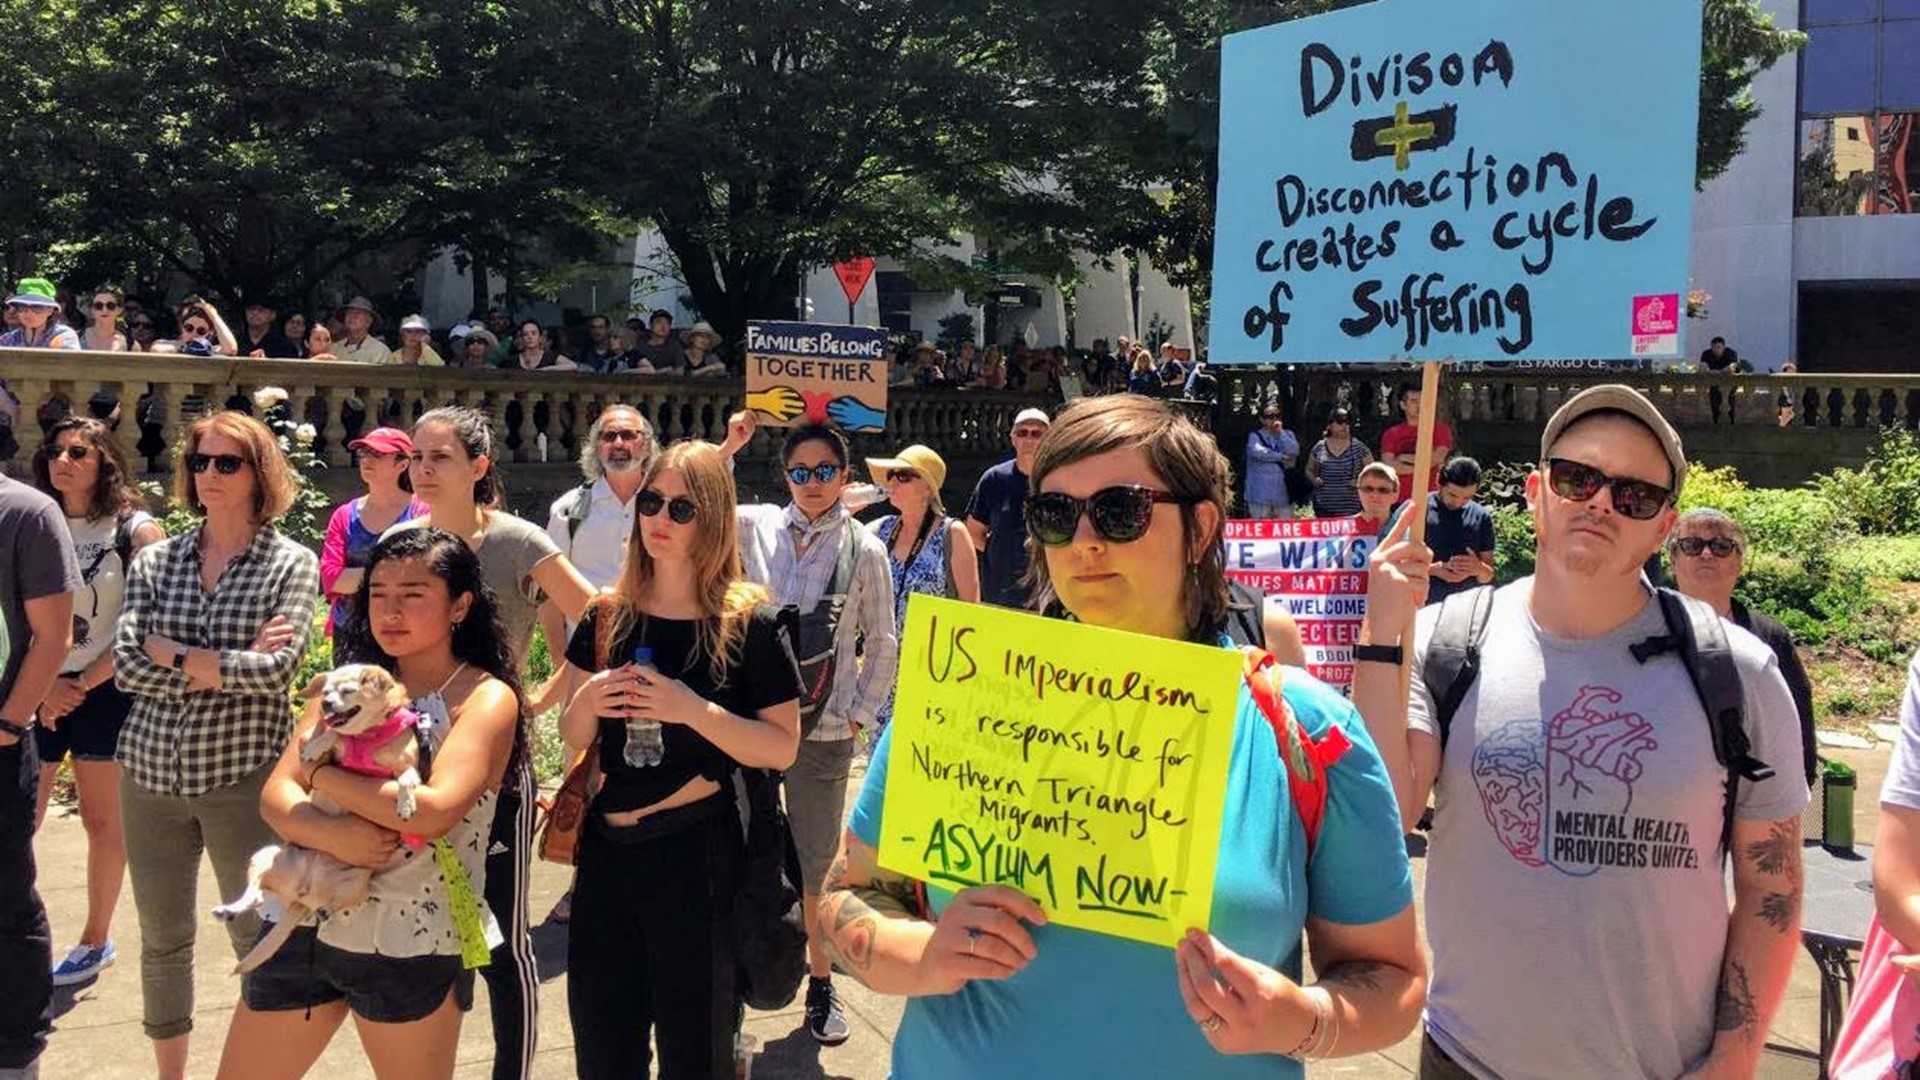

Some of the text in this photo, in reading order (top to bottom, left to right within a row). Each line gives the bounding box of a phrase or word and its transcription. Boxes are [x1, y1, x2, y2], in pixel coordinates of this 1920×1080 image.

[1276, 147, 1578, 228] Disconnection
[1255, 173, 1658, 276] creates a cycle
[1243, 272, 1533, 356] of Suffering
[747, 325, 883, 358] FAMILIES BELONG
[753, 355, 876, 384] TOGETHER
[1225, 522, 1264, 537] OPLE
[1272, 522, 1301, 537] ARE
[1279, 539, 1367, 570] WINS
[1291, 575, 1361, 592] MATTER
[1289, 598, 1366, 616] WELCOME
[1298, 623, 1360, 643] ECTED
[927, 615, 978, 684] US
[1316, 650, 1352, 662] BODI
[1317, 666, 1352, 680] PROF
[925, 700, 1193, 788] is responsible for
[911, 742, 1189, 840] Northern Triangle
[979, 795, 1097, 846] Migrants.
[1555, 809, 1690, 845] MENTAL HEALTH
[1554, 836, 1648, 868] PROVIDERS
